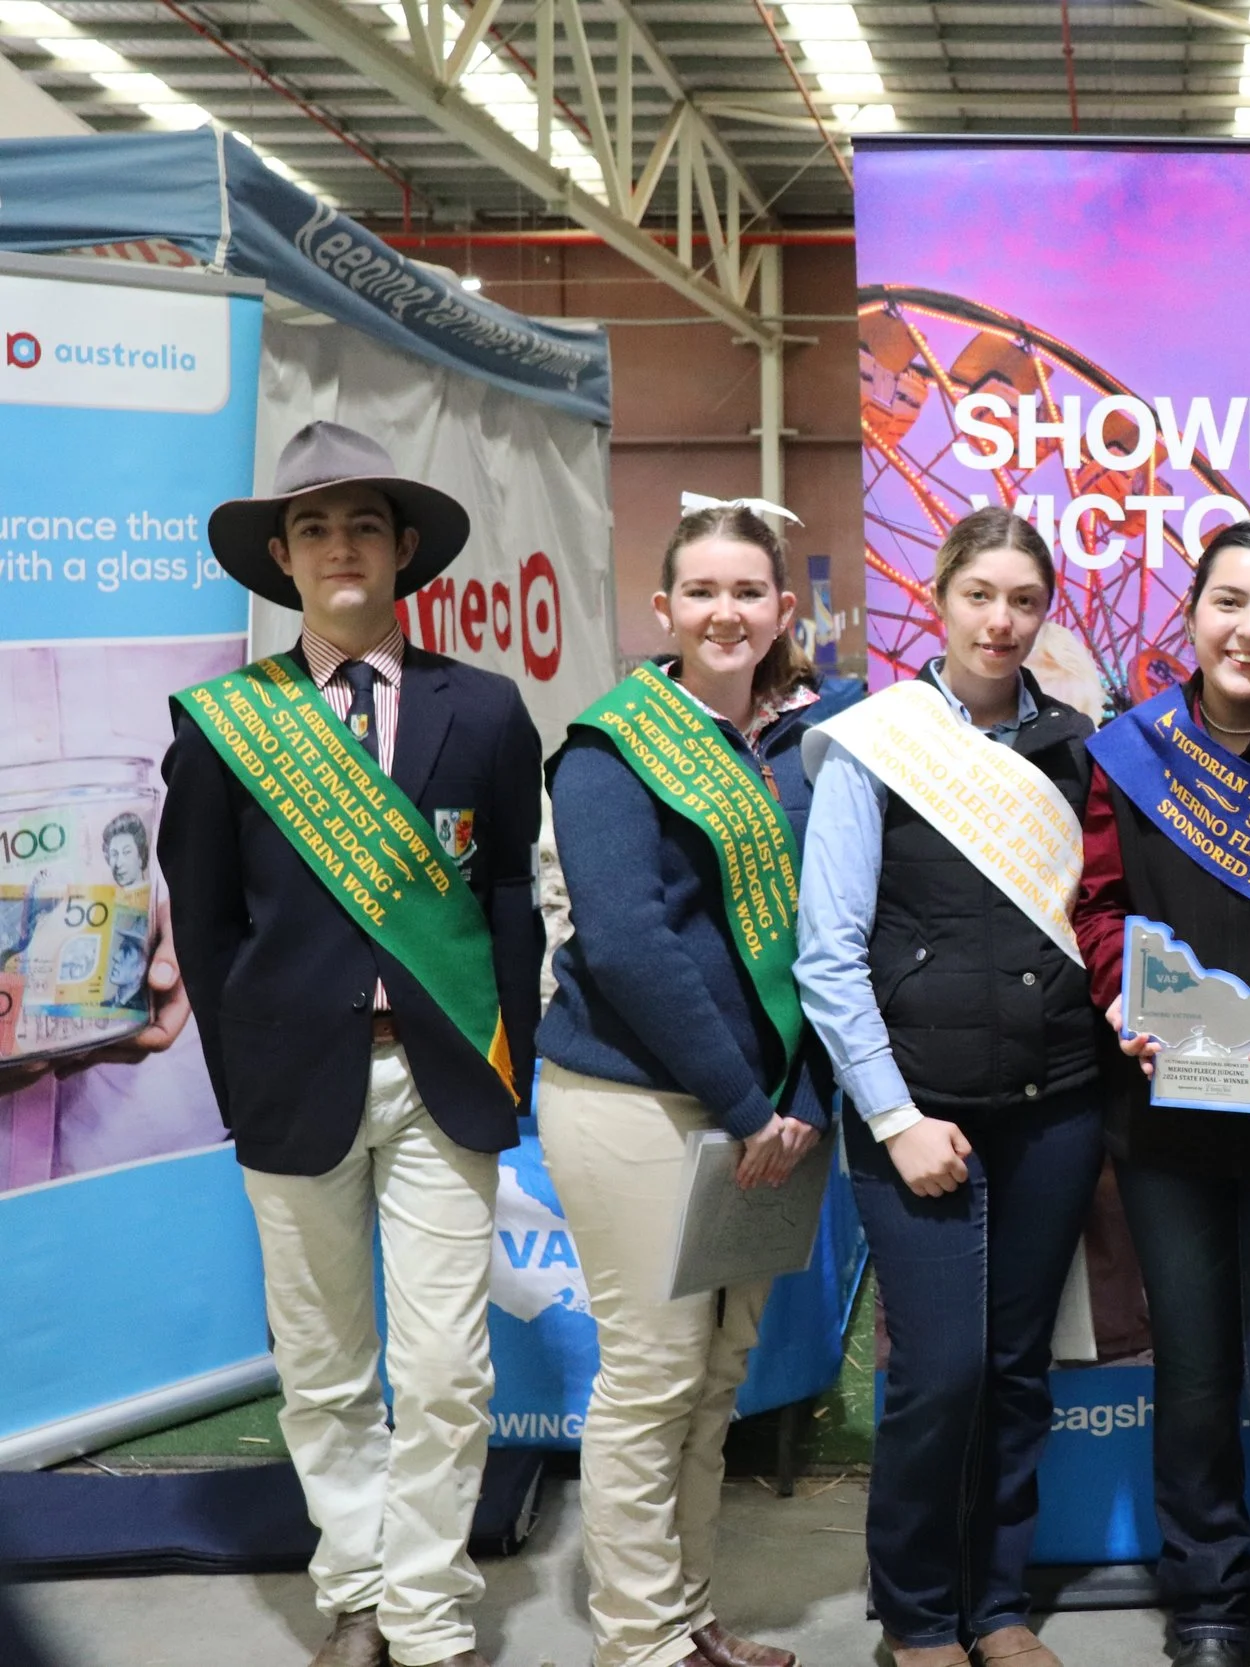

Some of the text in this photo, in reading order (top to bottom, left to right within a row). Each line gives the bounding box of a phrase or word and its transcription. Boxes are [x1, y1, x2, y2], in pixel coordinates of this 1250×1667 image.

[54, 342, 197, 372] australia
[126, 511, 199, 543] that
[0, 550, 53, 582] ith
[63, 556, 86, 582] a
[97, 549, 188, 593] glass
[224, 689, 393, 893] MERINO FLEECE JUDGING
[272, 710, 382, 836] STATE FINALIST
[296, 702, 387, 810] AGRICULTURAL
[383, 807, 432, 863] SHOWS
[424, 859, 451, 897] LTD.
[700, 735, 786, 850] AGRICULTURAL
[1171, 727, 1249, 794] VICTORIAN
[191, 687, 386, 927] SPONSORED BY RIVERINA WOOL
[599, 711, 765, 960] SPONSORED BY RIVERINA WOOL
[633, 711, 773, 929] MERINO FLEECE JUDGING
[684, 737, 776, 872] STATE FINALIST
[947, 778, 1010, 839] FLEECE
[966, 763, 1062, 863] STATE FINAL
[1157, 798, 1249, 879] SPONSORED
[1169, 778, 1229, 838] MERINO
[957, 821, 982, 845] BY
[979, 841, 1051, 913] RIVERINA
[63, 899, 109, 928] 50
[1156, 974, 1179, 984] VAS
[1168, 1066, 1193, 1074] MERINO
[1217, 1069, 1245, 1077] JUDGING
[1223, 1077, 1249, 1085] WINNER
